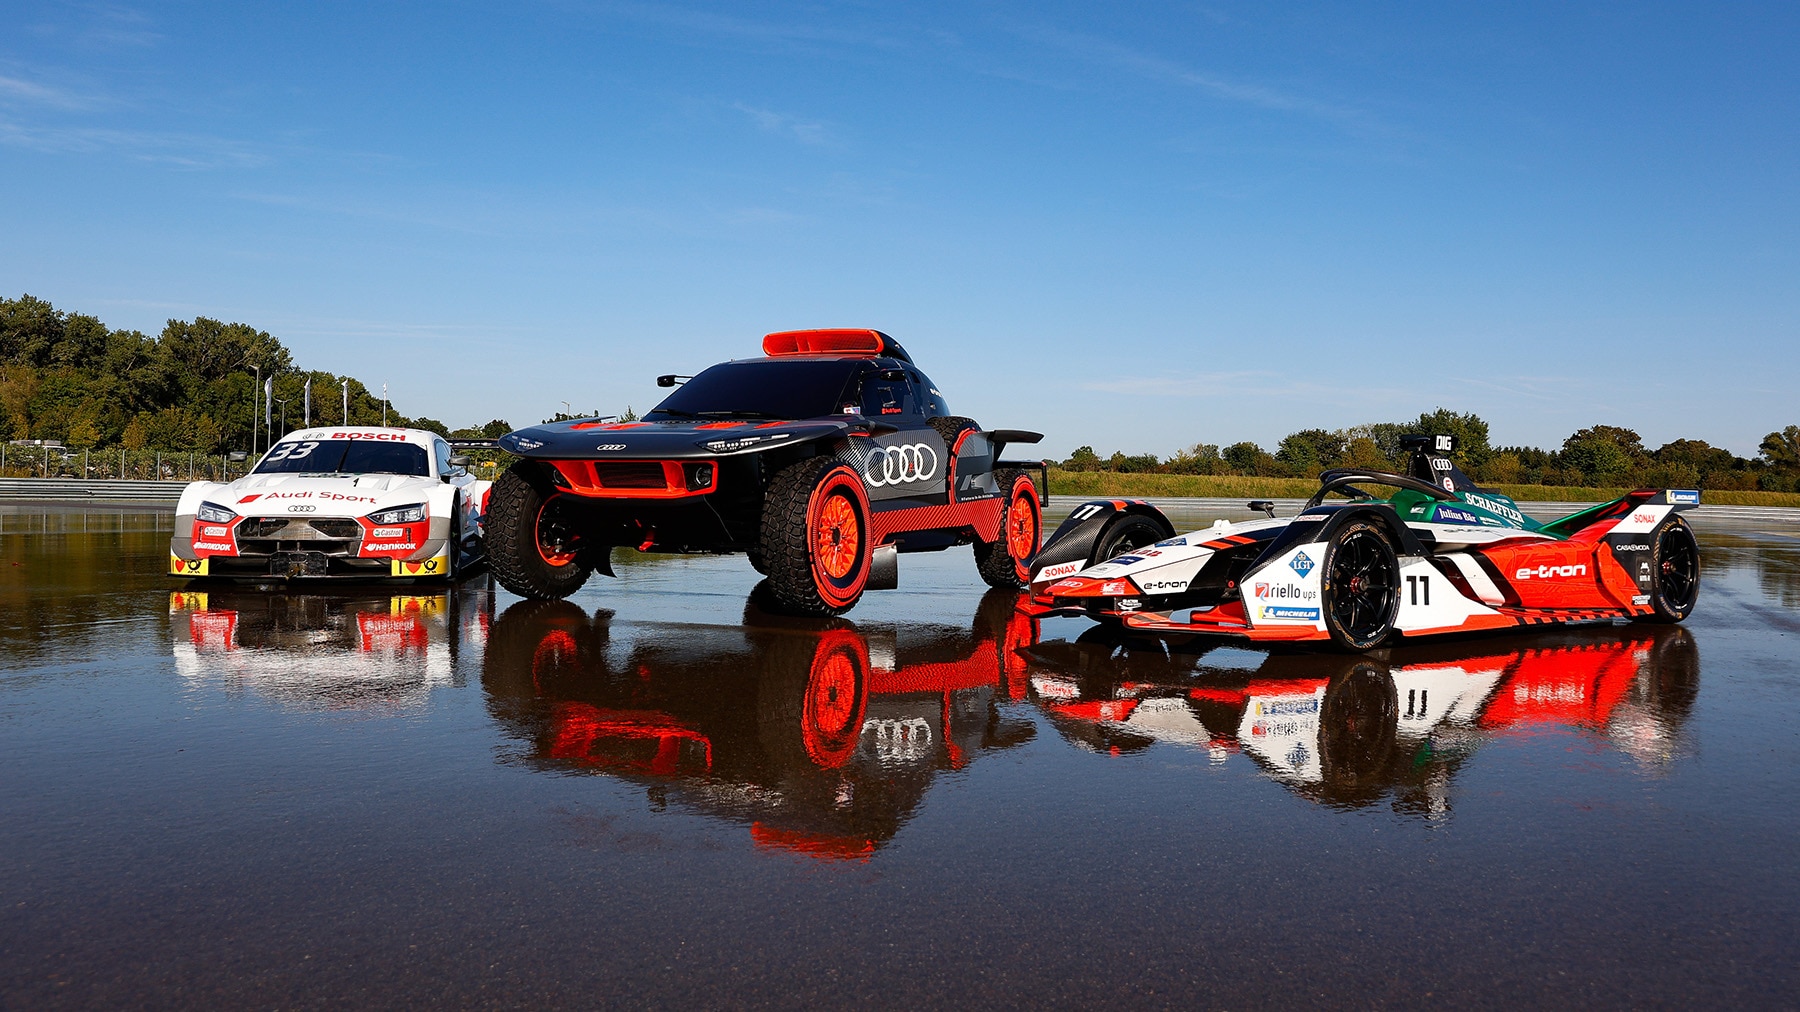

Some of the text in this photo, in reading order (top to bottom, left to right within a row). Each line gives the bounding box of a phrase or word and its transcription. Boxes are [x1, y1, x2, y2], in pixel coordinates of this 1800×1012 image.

[331, 433, 406, 441] BOSCH
[1436, 435, 1452, 450] DIG
[267, 442, 320, 461] 33
[354, 478, 360, 487] 1
[265, 491, 377, 504] Audi Sport
[1072, 505, 1104, 520] 11
[1438, 508, 1463, 520] Julius
[1465, 493, 1525, 523] SCHAEFFLER
[1634, 514, 1655, 523] SONAX
[1045, 565, 1076, 577] SONAX
[1294, 561, 1311, 570] LGT
[1516, 564, 1586, 579] e-tron
[1144, 581, 1188, 590] e-tron
[1406, 576, 1429, 606] 11
[1271, 583, 1317, 601] riello ups
[1276, 610, 1318, 618] MICHELIN
